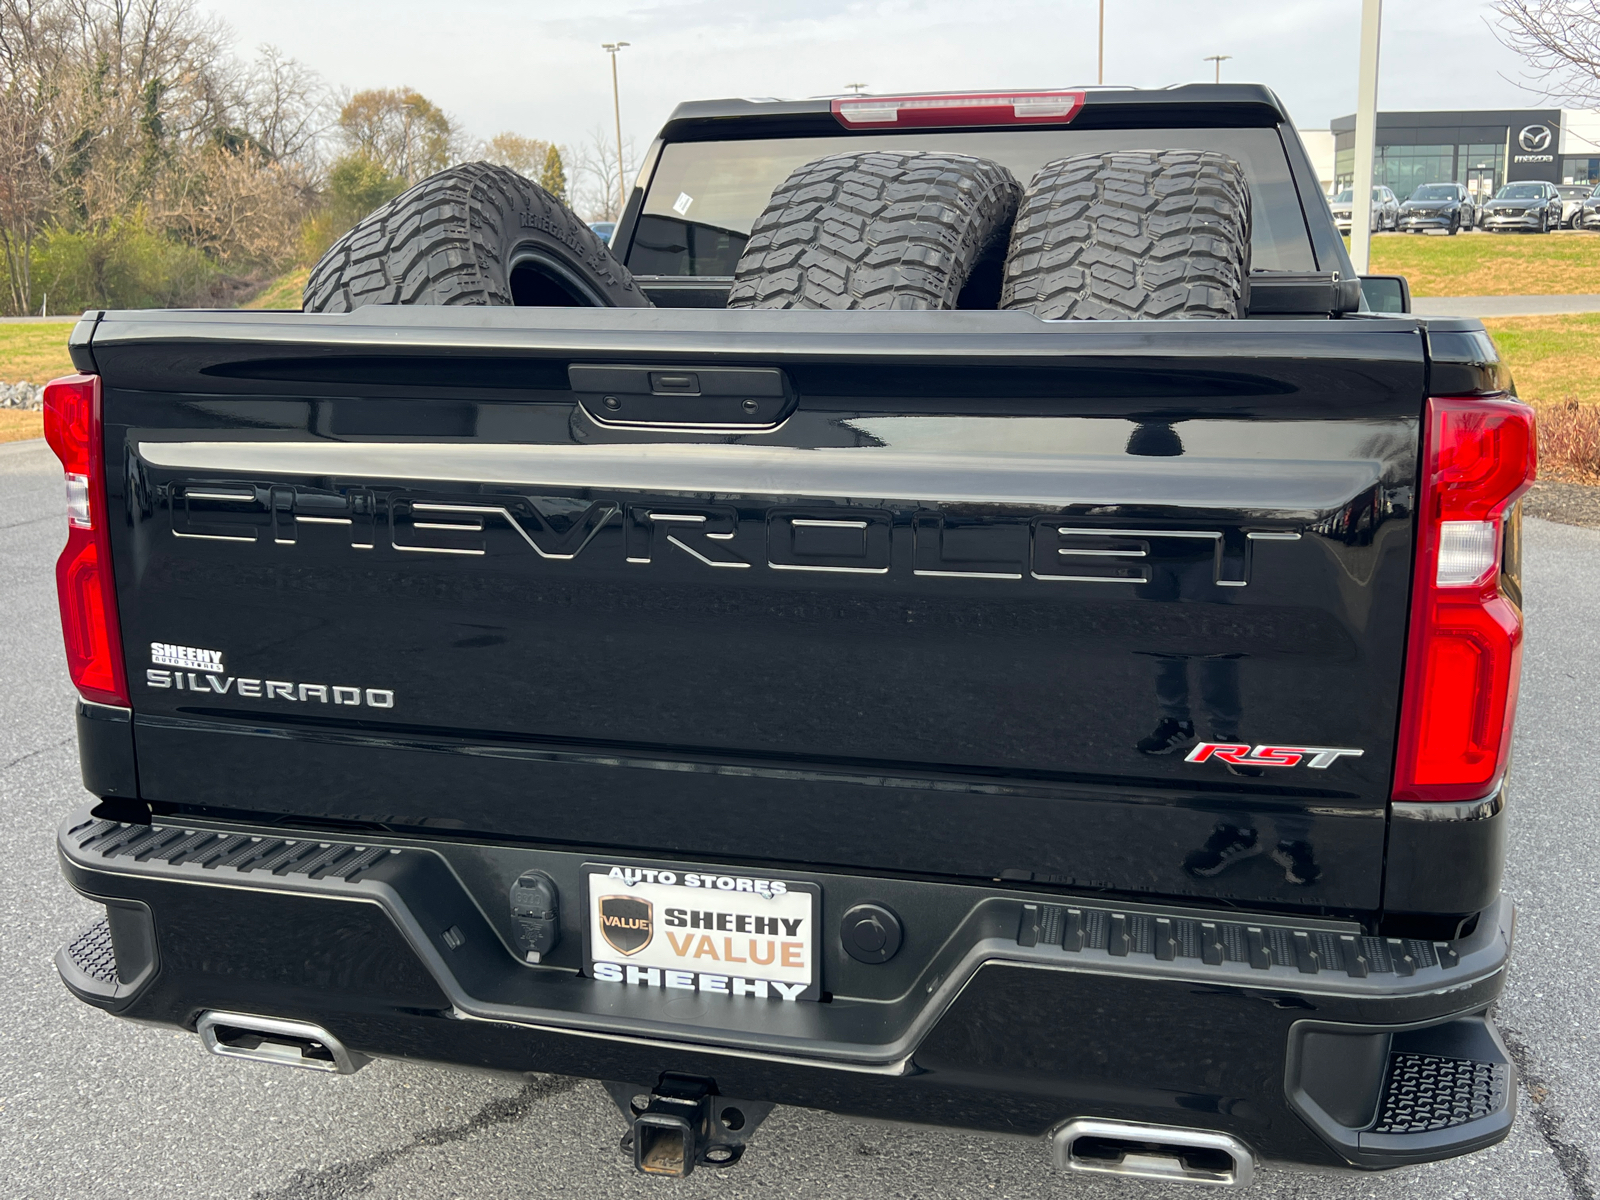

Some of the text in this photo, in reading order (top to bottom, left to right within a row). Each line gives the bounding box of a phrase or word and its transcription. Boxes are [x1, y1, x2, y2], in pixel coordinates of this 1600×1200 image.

[519, 211, 619, 288] RENEGADE R/T
[166, 480, 1304, 587] CHEVROLET
[151, 642, 222, 664] SHEEHY
[154, 656, 180, 665] AUTO
[146, 668, 395, 709] SILVERADO
[1184, 741, 1365, 769] RST
[608, 866, 787, 895] AUTO STORES
[602, 914, 650, 931] VALUE
[664, 907, 804, 937] SHEEHY
[664, 930, 805, 968] VALUE
[593, 962, 808, 1001] SHEEHY
